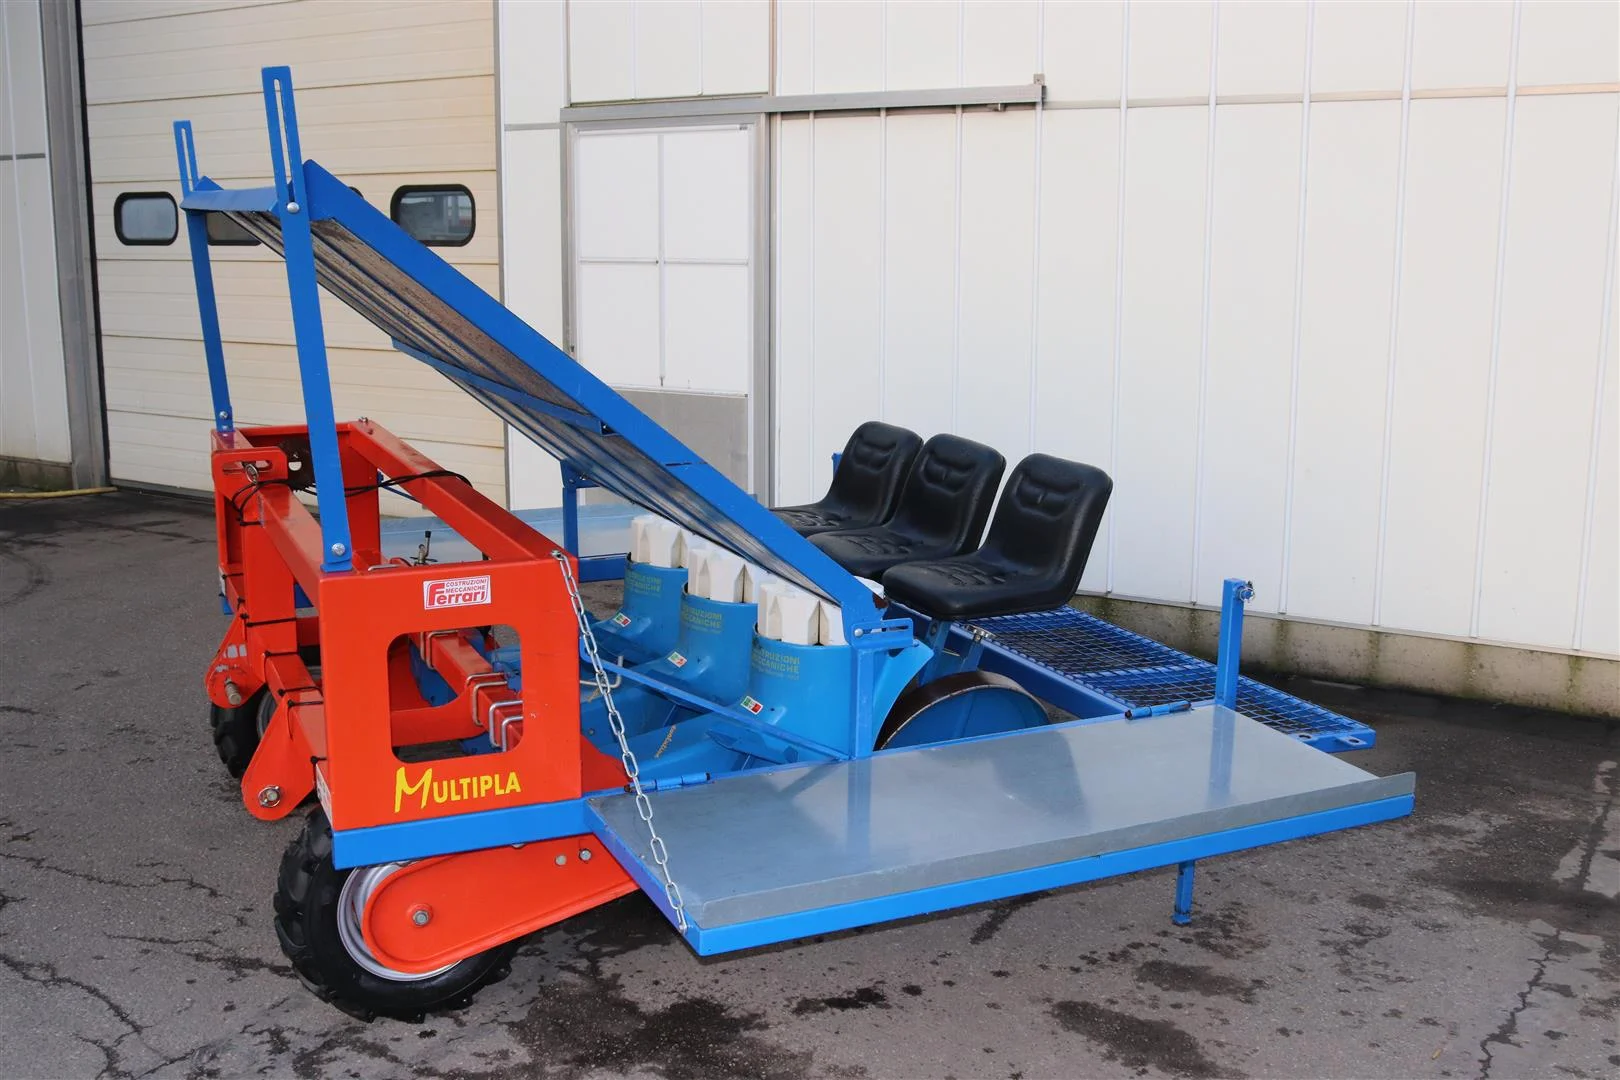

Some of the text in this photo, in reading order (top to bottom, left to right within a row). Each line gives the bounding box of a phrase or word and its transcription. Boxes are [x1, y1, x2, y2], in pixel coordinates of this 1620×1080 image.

[445, 579, 487, 588] COSTRUZIONI
[445, 585, 486, 594] MECCANICHE
[427, 582, 486, 606] Ferrari
[394, 766, 522, 813] MULTIPLA
